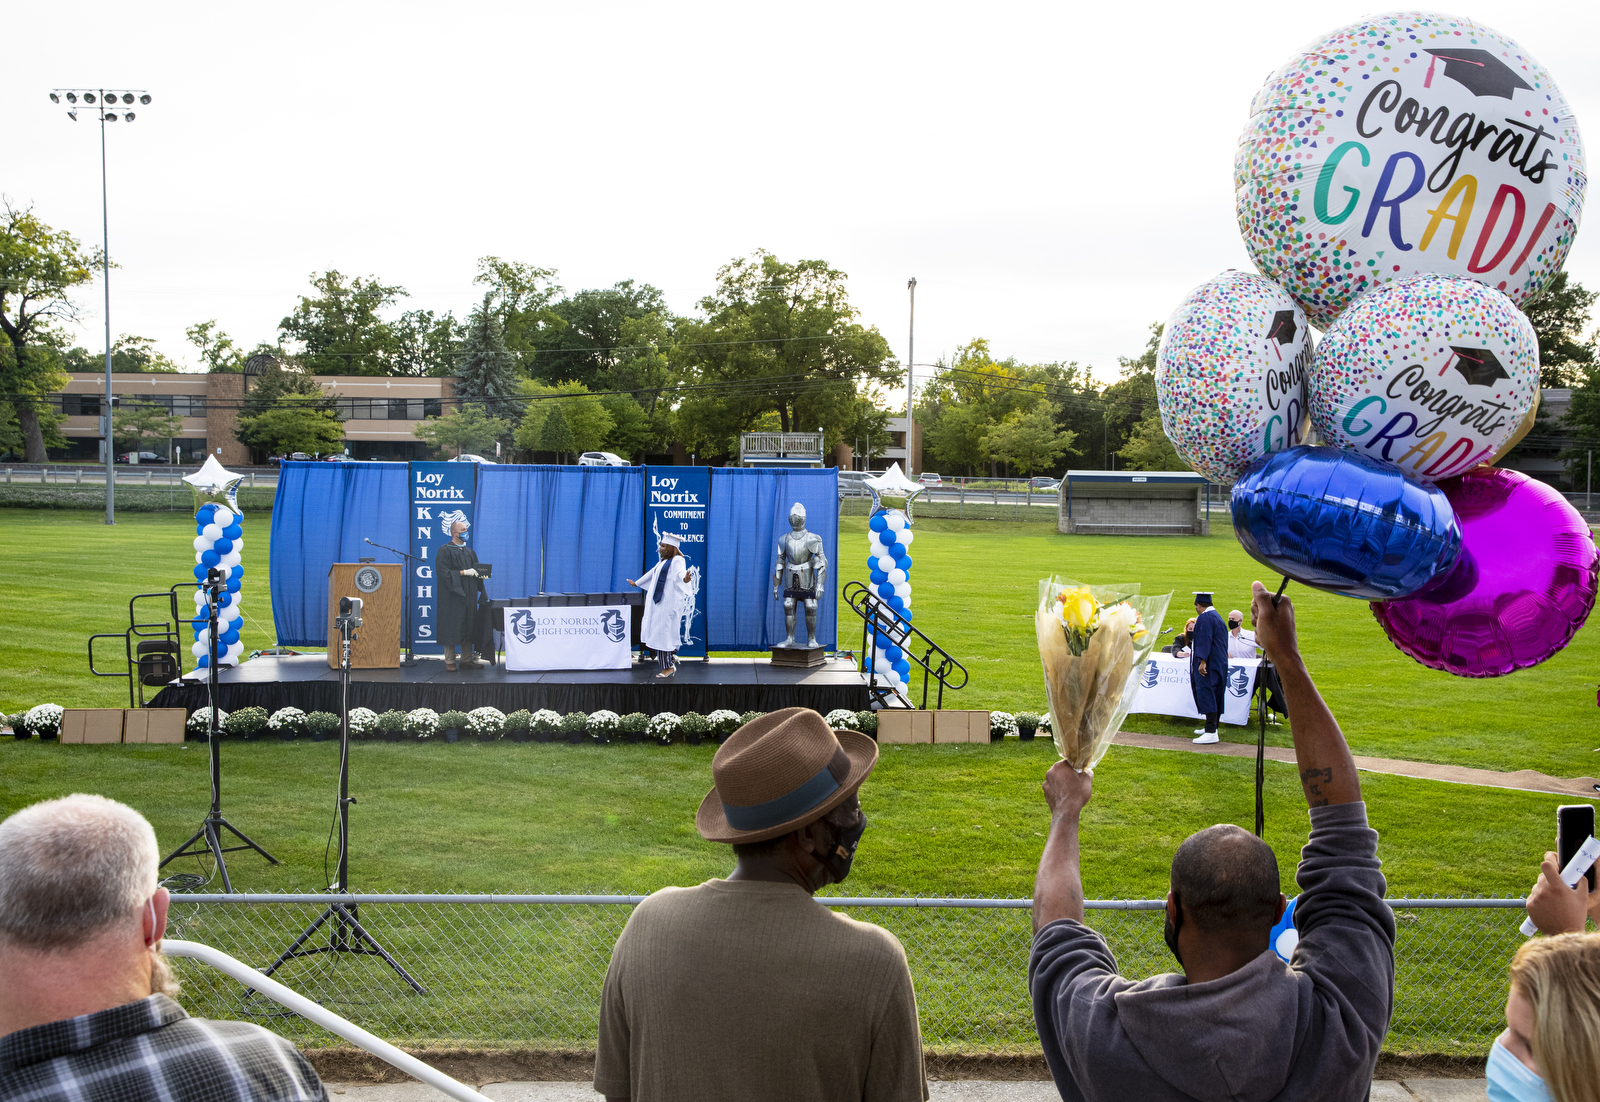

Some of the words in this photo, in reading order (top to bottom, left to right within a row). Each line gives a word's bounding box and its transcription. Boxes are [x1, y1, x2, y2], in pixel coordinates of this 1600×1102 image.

[1356, 80, 1558, 193] Congrats
[1313, 141, 1557, 292] GRAD!
[1386, 364, 1511, 438] Congrats
[416, 471, 444, 486] Loy
[651, 475, 679, 490] Loy
[416, 486, 464, 499] Norrix
[651, 490, 699, 503] Norrix
[663, 510, 705, 519] COMMITMENT
[680, 522, 688, 530] TO
[416, 507, 433, 638] KNIGHTS
[537, 617, 557, 625] LOY
[560, 617, 600, 625] NORRIX
[537, 627, 562, 635] HIGH
[564, 627, 601, 635] SCHOOL
[1160, 676, 1183, 684] HIGH
